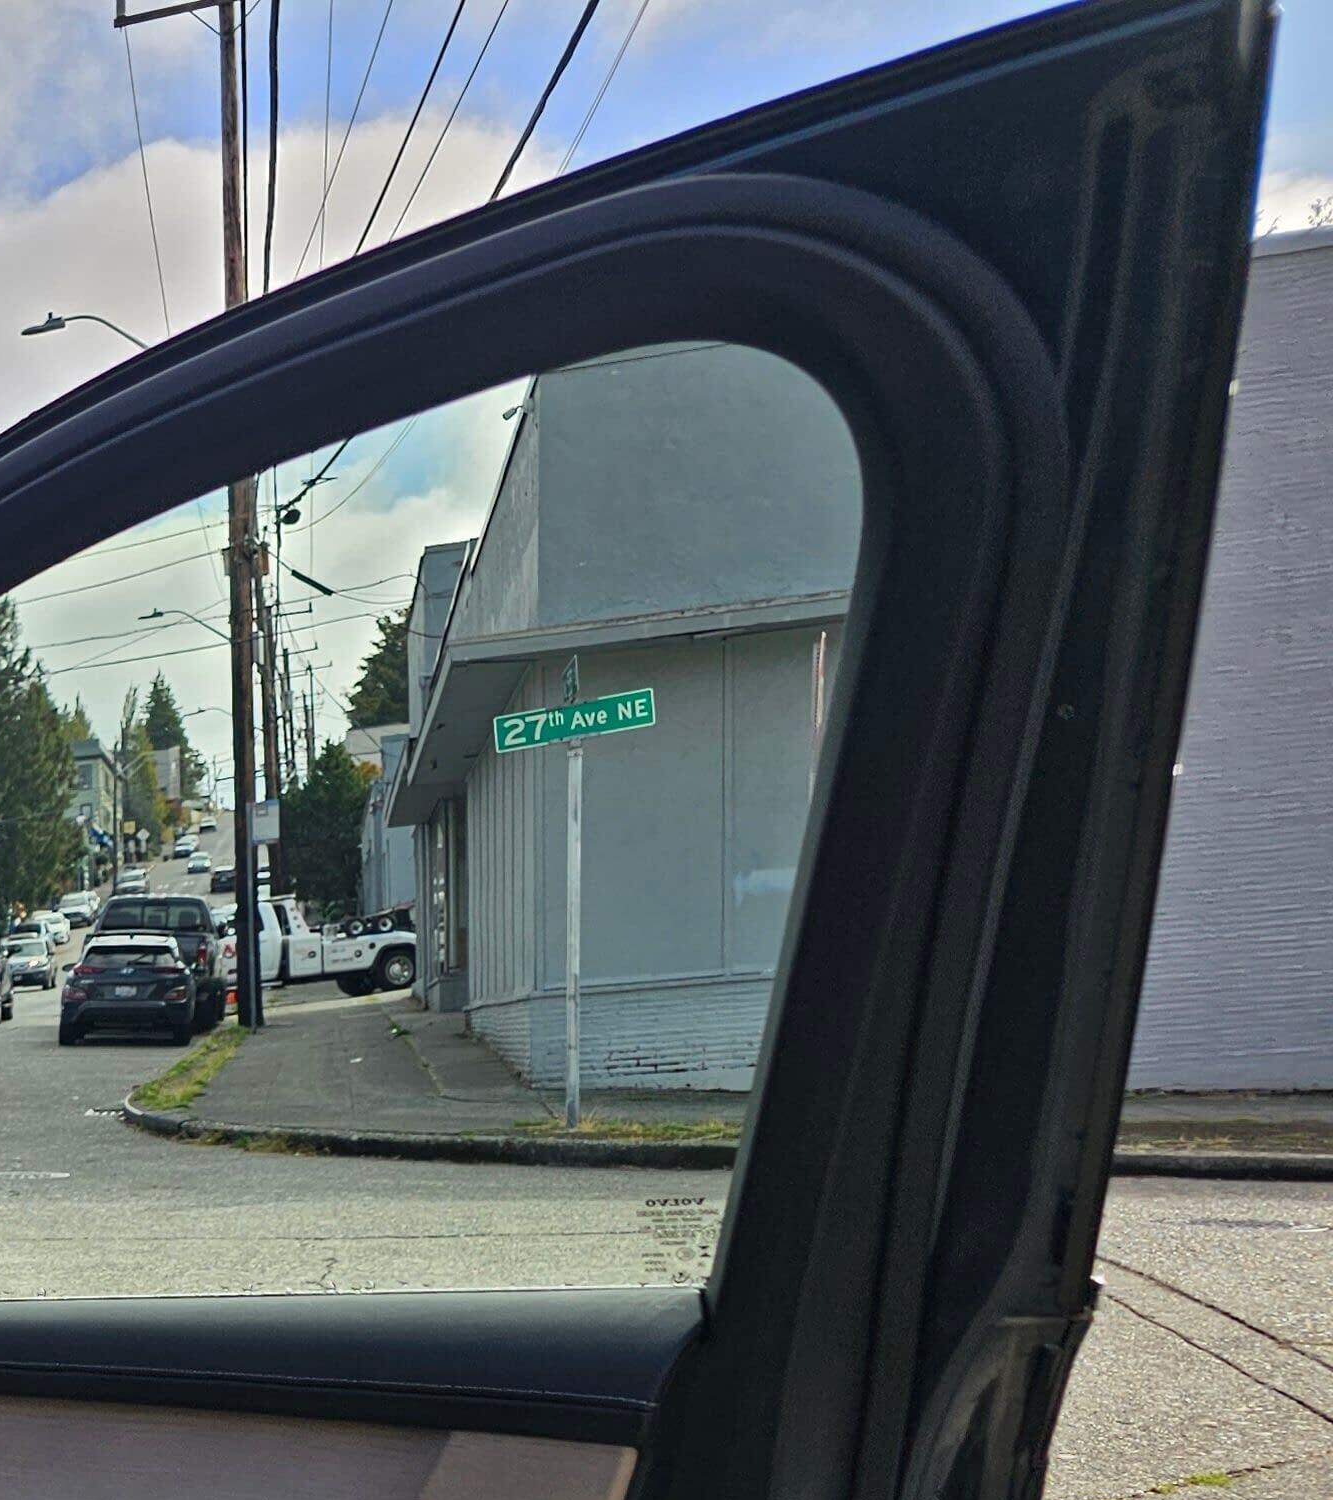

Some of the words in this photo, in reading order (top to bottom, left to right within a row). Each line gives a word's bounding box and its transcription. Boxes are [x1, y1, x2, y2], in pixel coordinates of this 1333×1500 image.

[503, 710, 564, 746] 27th
[570, 710, 608, 730] Ave
[617, 698, 649, 721] NE
